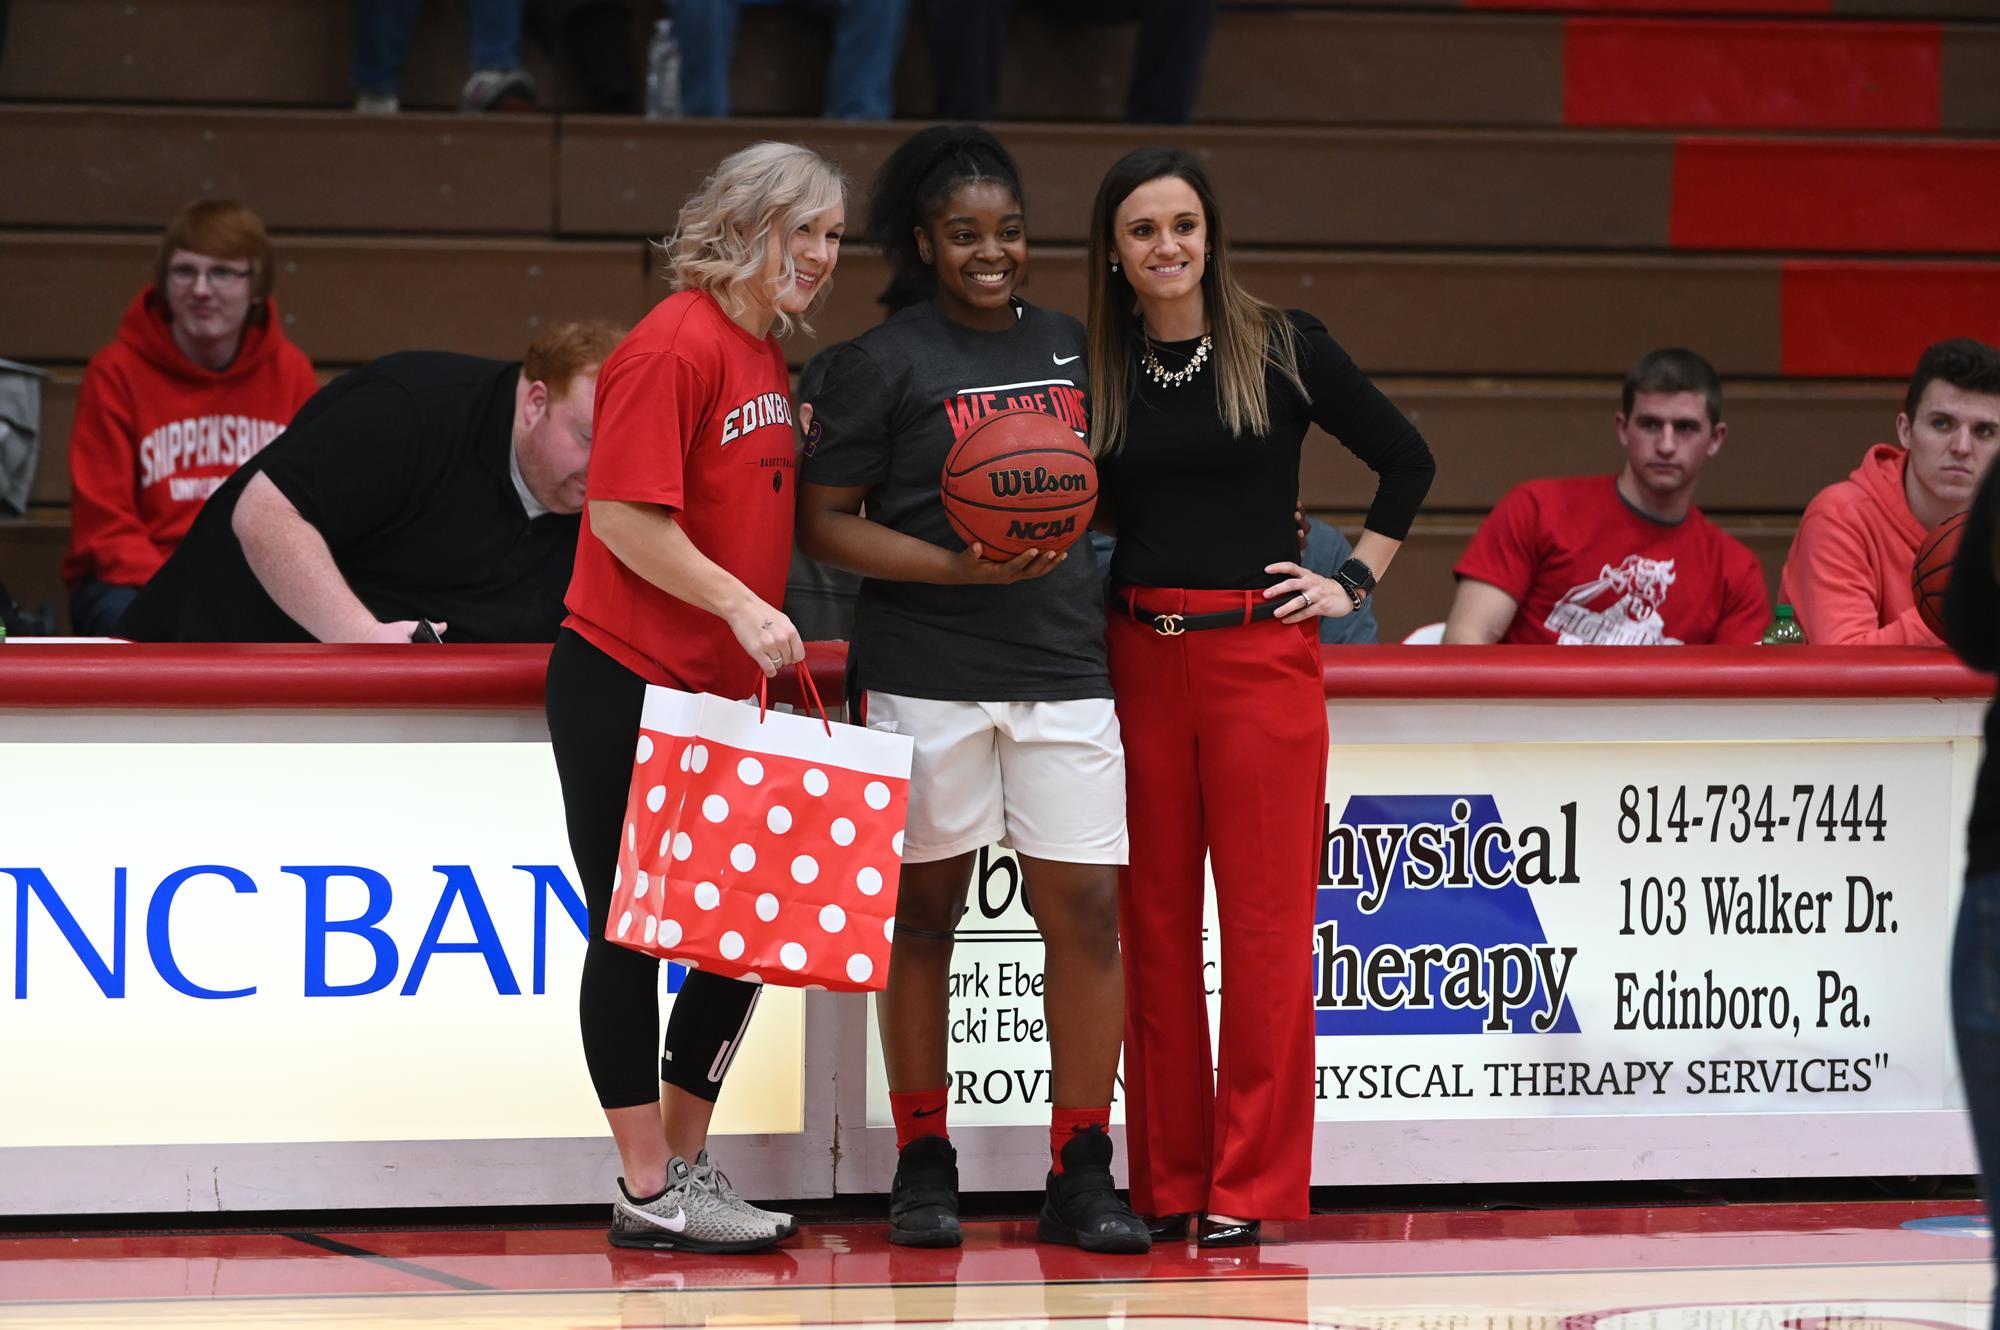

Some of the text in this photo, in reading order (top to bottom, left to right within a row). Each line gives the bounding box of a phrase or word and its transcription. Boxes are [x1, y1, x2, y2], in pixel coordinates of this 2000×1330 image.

[720, 392, 793, 446] EDINBO
[944, 393, 998, 440] WE
[1048, 385, 1088, 431] ONE
[988, 466, 1088, 498] Wilson
[1006, 515, 1076, 540] NCAA
[1617, 784, 1888, 844] 814-734-7444
[1317, 800, 1581, 911] hysical
[0, 864, 686, 1000] NC BAN
[1618, 873, 1899, 936] 103 Walker Dr.
[949, 961, 1045, 998] ark Ebe
[1313, 923, 1578, 1031] herapy
[1613, 969, 1871, 1038] Edinboro, Pa.
[950, 1006, 1049, 1044] cki Ebe
[1314, 1052, 1889, 1099] HYSICAL THERAPY SERVICES"
